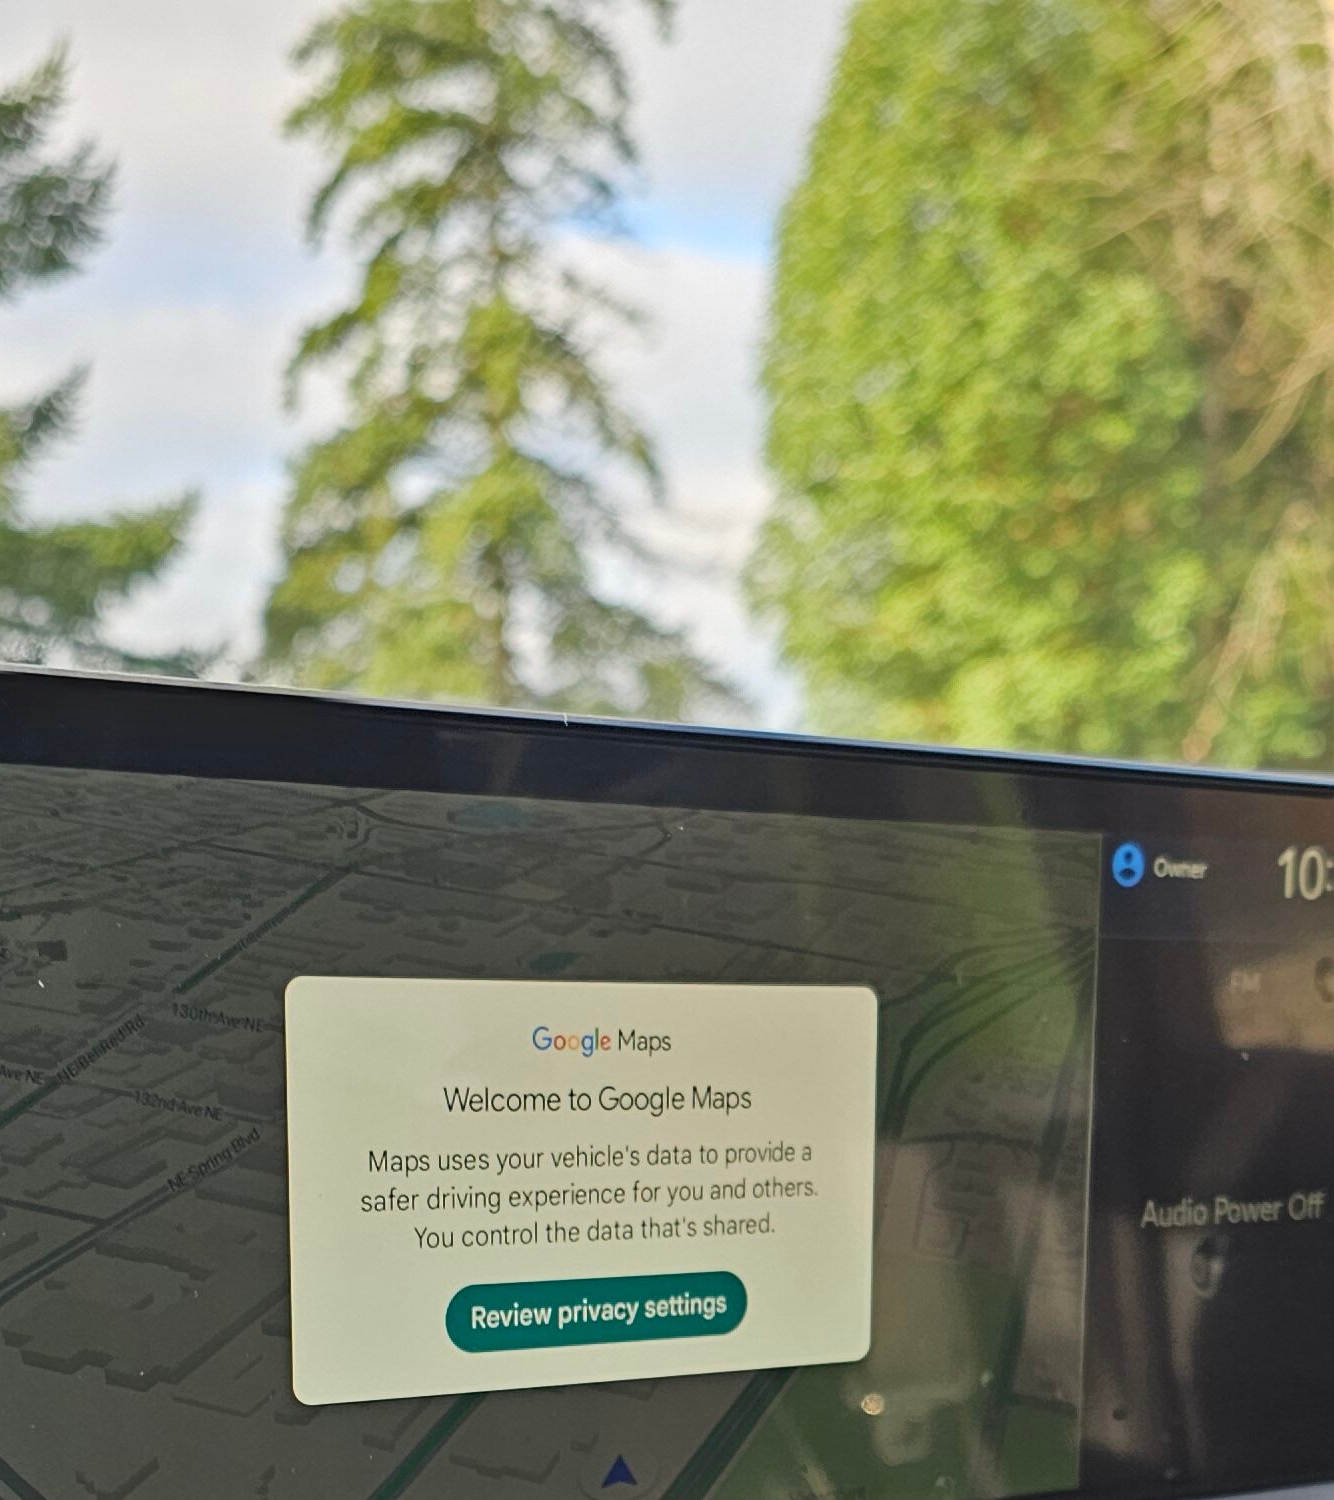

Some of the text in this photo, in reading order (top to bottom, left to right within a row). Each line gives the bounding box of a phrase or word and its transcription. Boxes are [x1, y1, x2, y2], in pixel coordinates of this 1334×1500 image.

[1153, 855, 1208, 880] Owner
[125, 1013, 146, 1035] Rd
[171, 1002, 212, 1024] 130th
[244, 1015, 263, 1034] NE
[532, 1026, 672, 1057] Google Maps
[134, 1090, 176, 1112] 132nd
[204, 1105, 226, 1122] NE
[443, 1086, 752, 1116] Welcome to Google Maps
[167, 1127, 262, 1193] NE Spring Blvd
[368, 1140, 813, 1178] Maps uses your vehicle's data to provide a
[361, 1176, 819, 1214] safer driving experience for you and others.
[1140, 1191, 1326, 1229] Audio Power Off
[414, 1212, 776, 1250] You control the data that's shared.
[470, 1293, 728, 1331] Review privacy settings
